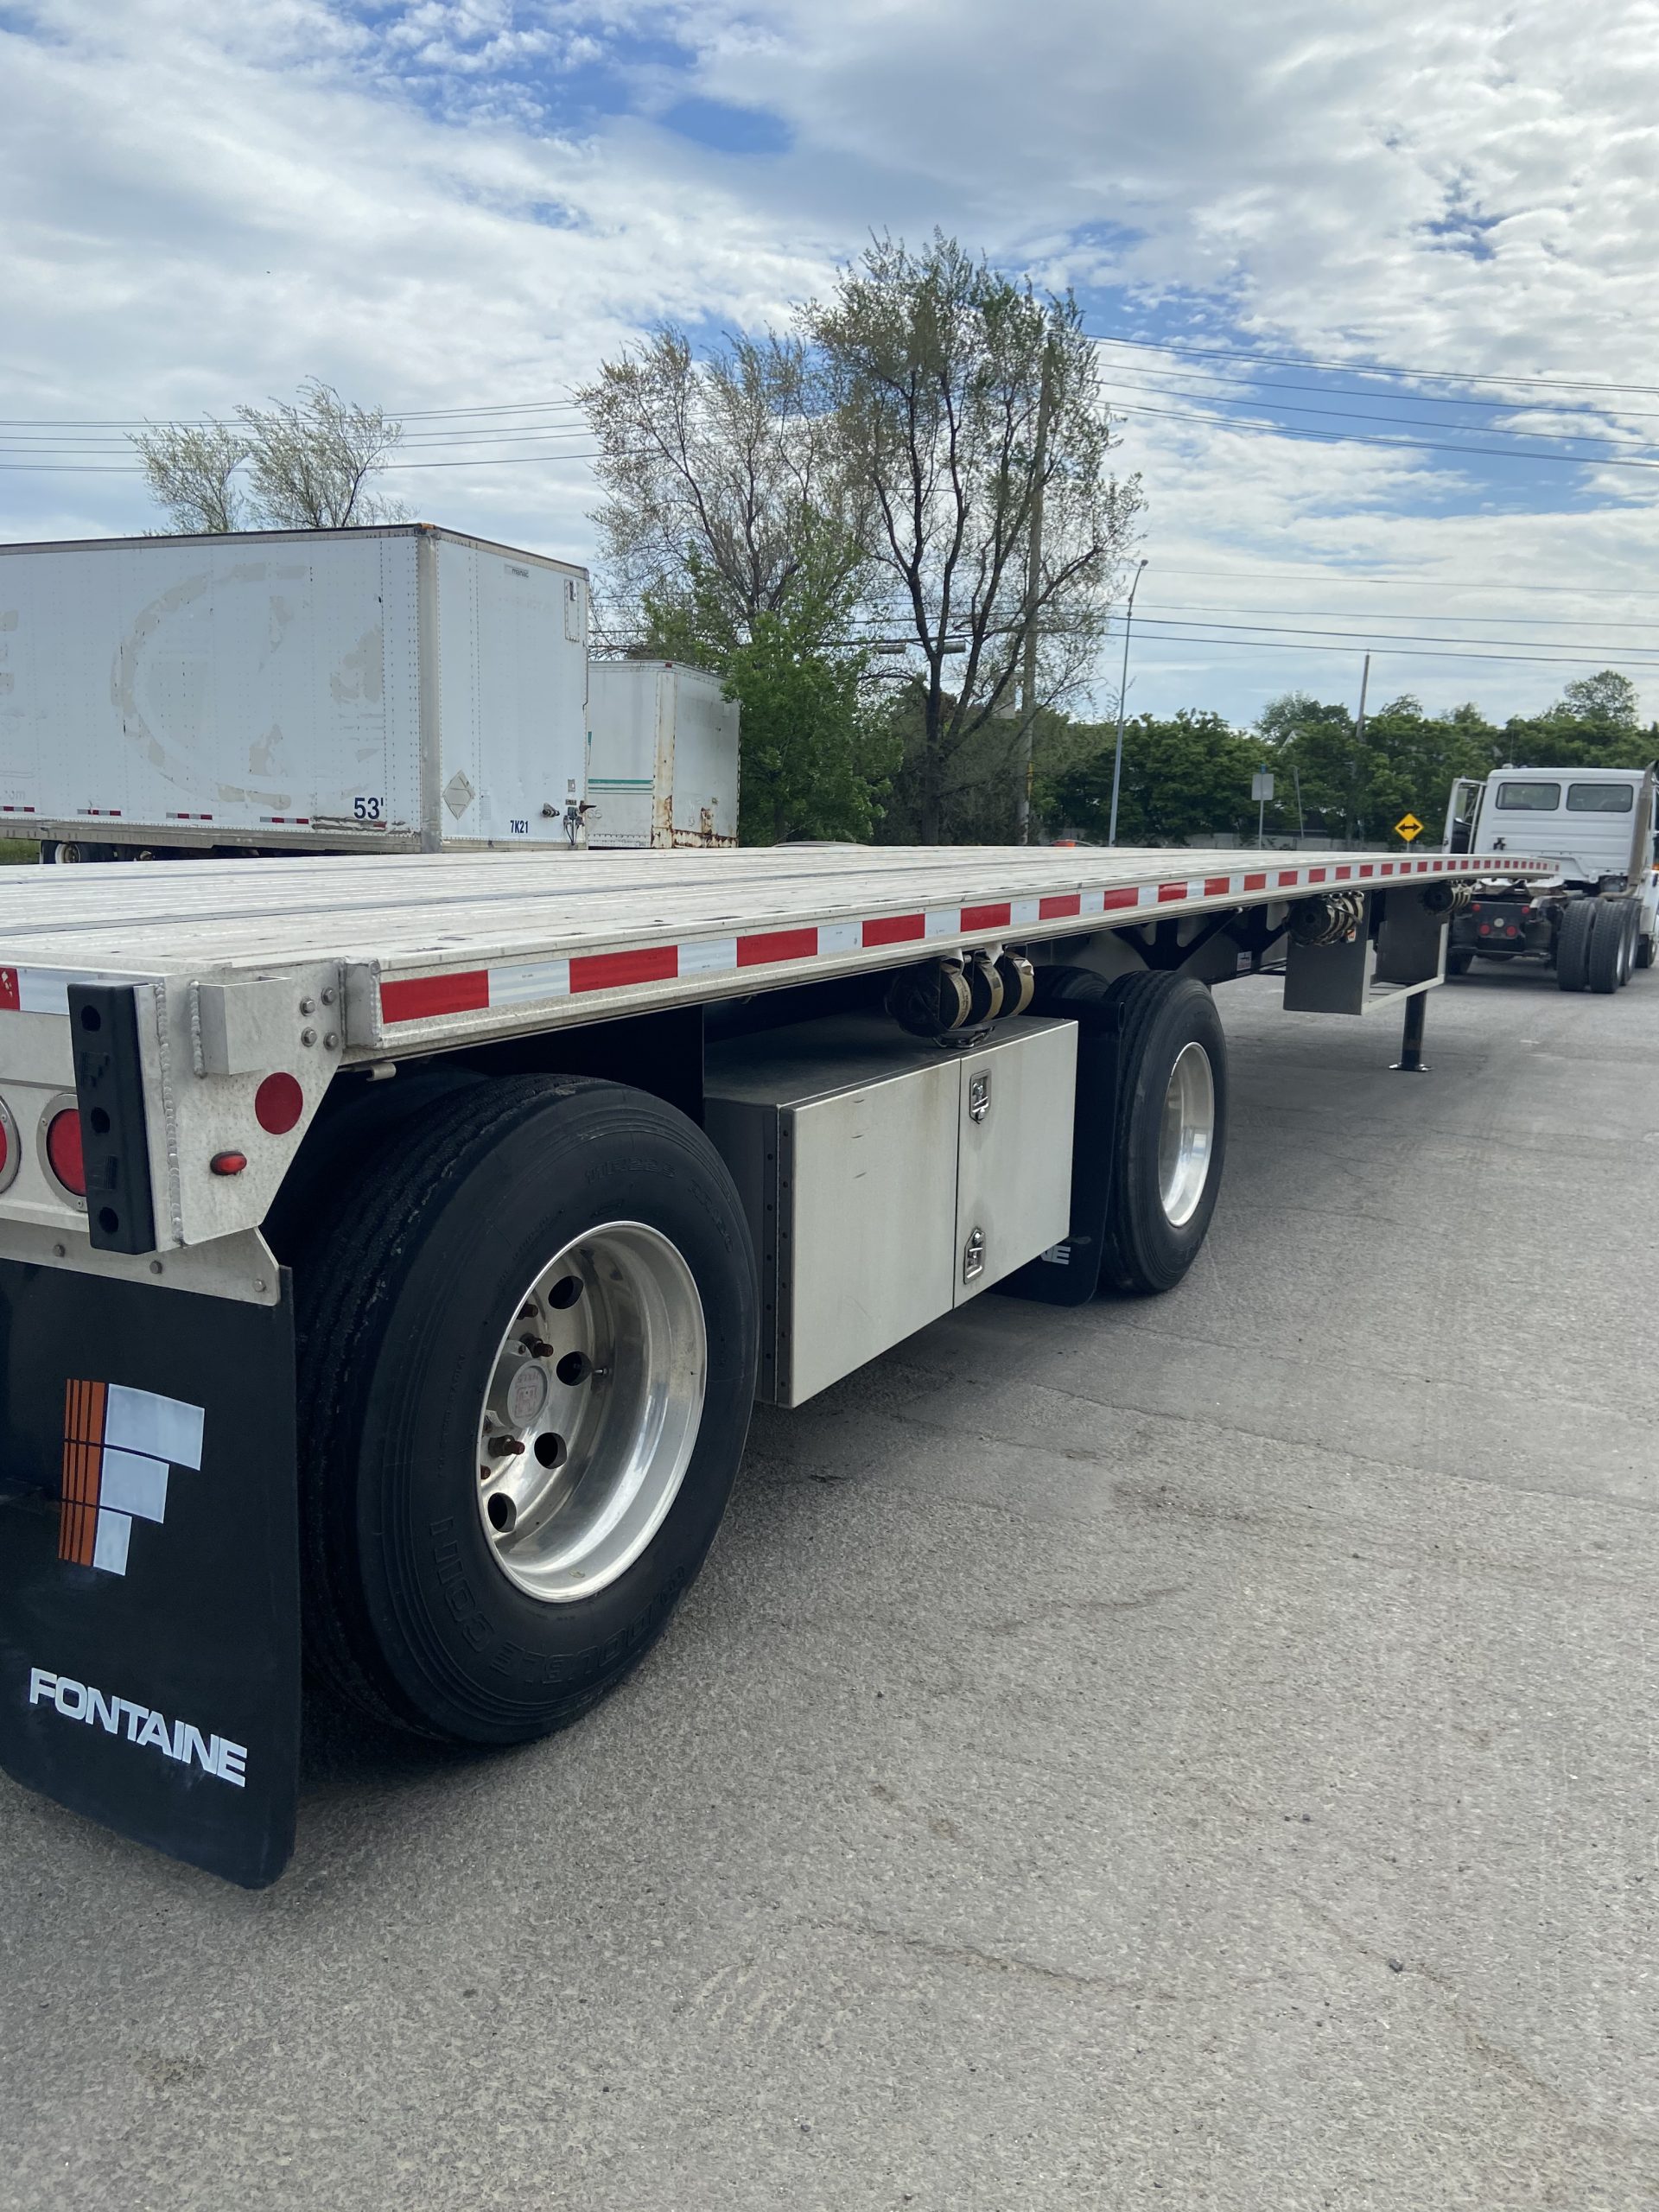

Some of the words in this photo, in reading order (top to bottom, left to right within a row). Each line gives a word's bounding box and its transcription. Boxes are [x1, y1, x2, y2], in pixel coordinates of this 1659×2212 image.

[353, 797, 384, 820] 53'
[510, 820, 529, 834] 7K21
[29, 1667, 248, 1788] FONTAINE
